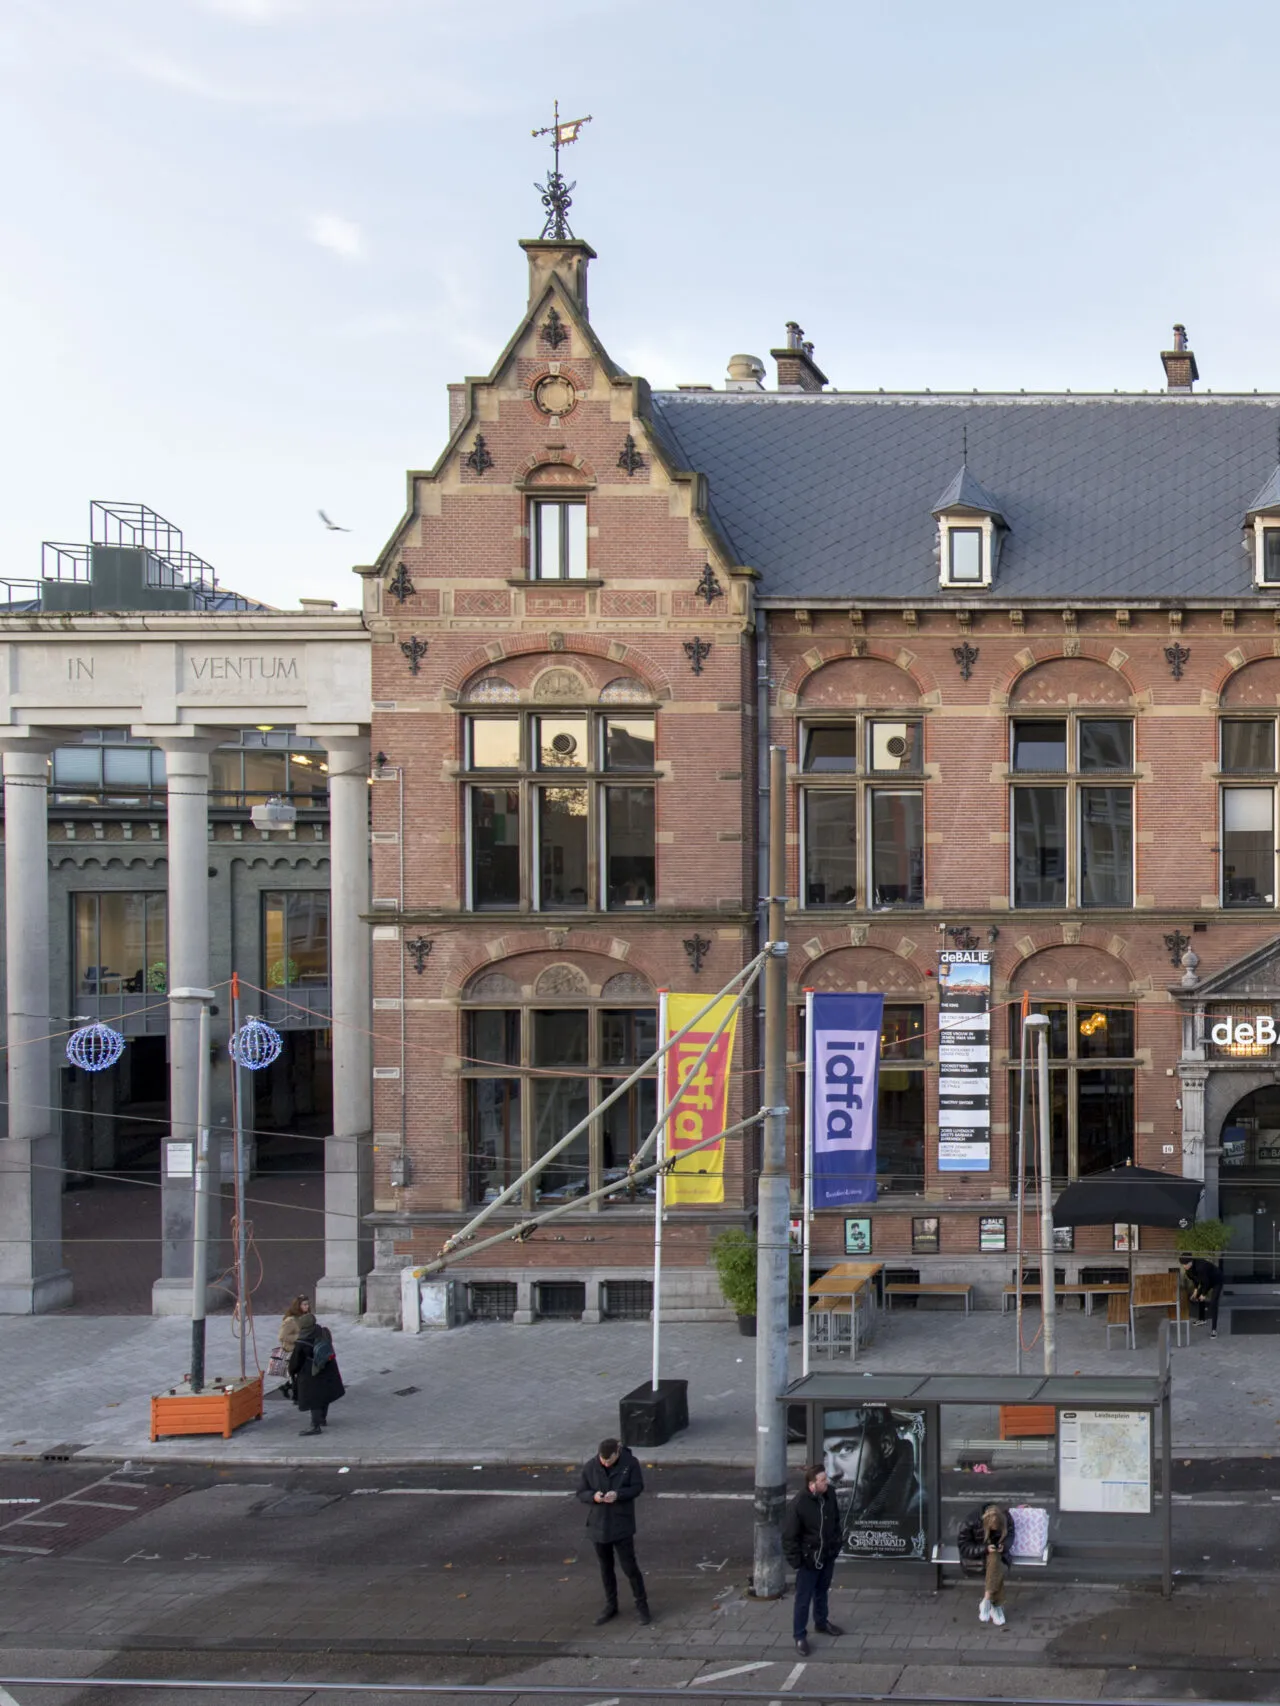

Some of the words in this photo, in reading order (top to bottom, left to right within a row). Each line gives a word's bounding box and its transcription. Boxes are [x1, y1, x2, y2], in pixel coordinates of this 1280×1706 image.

[68, 657, 95, 680] IN
[190, 656, 298, 680] VENTUM
[940, 952, 988, 963] deBALIE
[674, 1043, 718, 1140] idfa
[825, 1042, 864, 1140] idfa
[848, 1534, 906, 1547] GRINDELWALD
[866, 1530, 892, 1539] CRIMES
